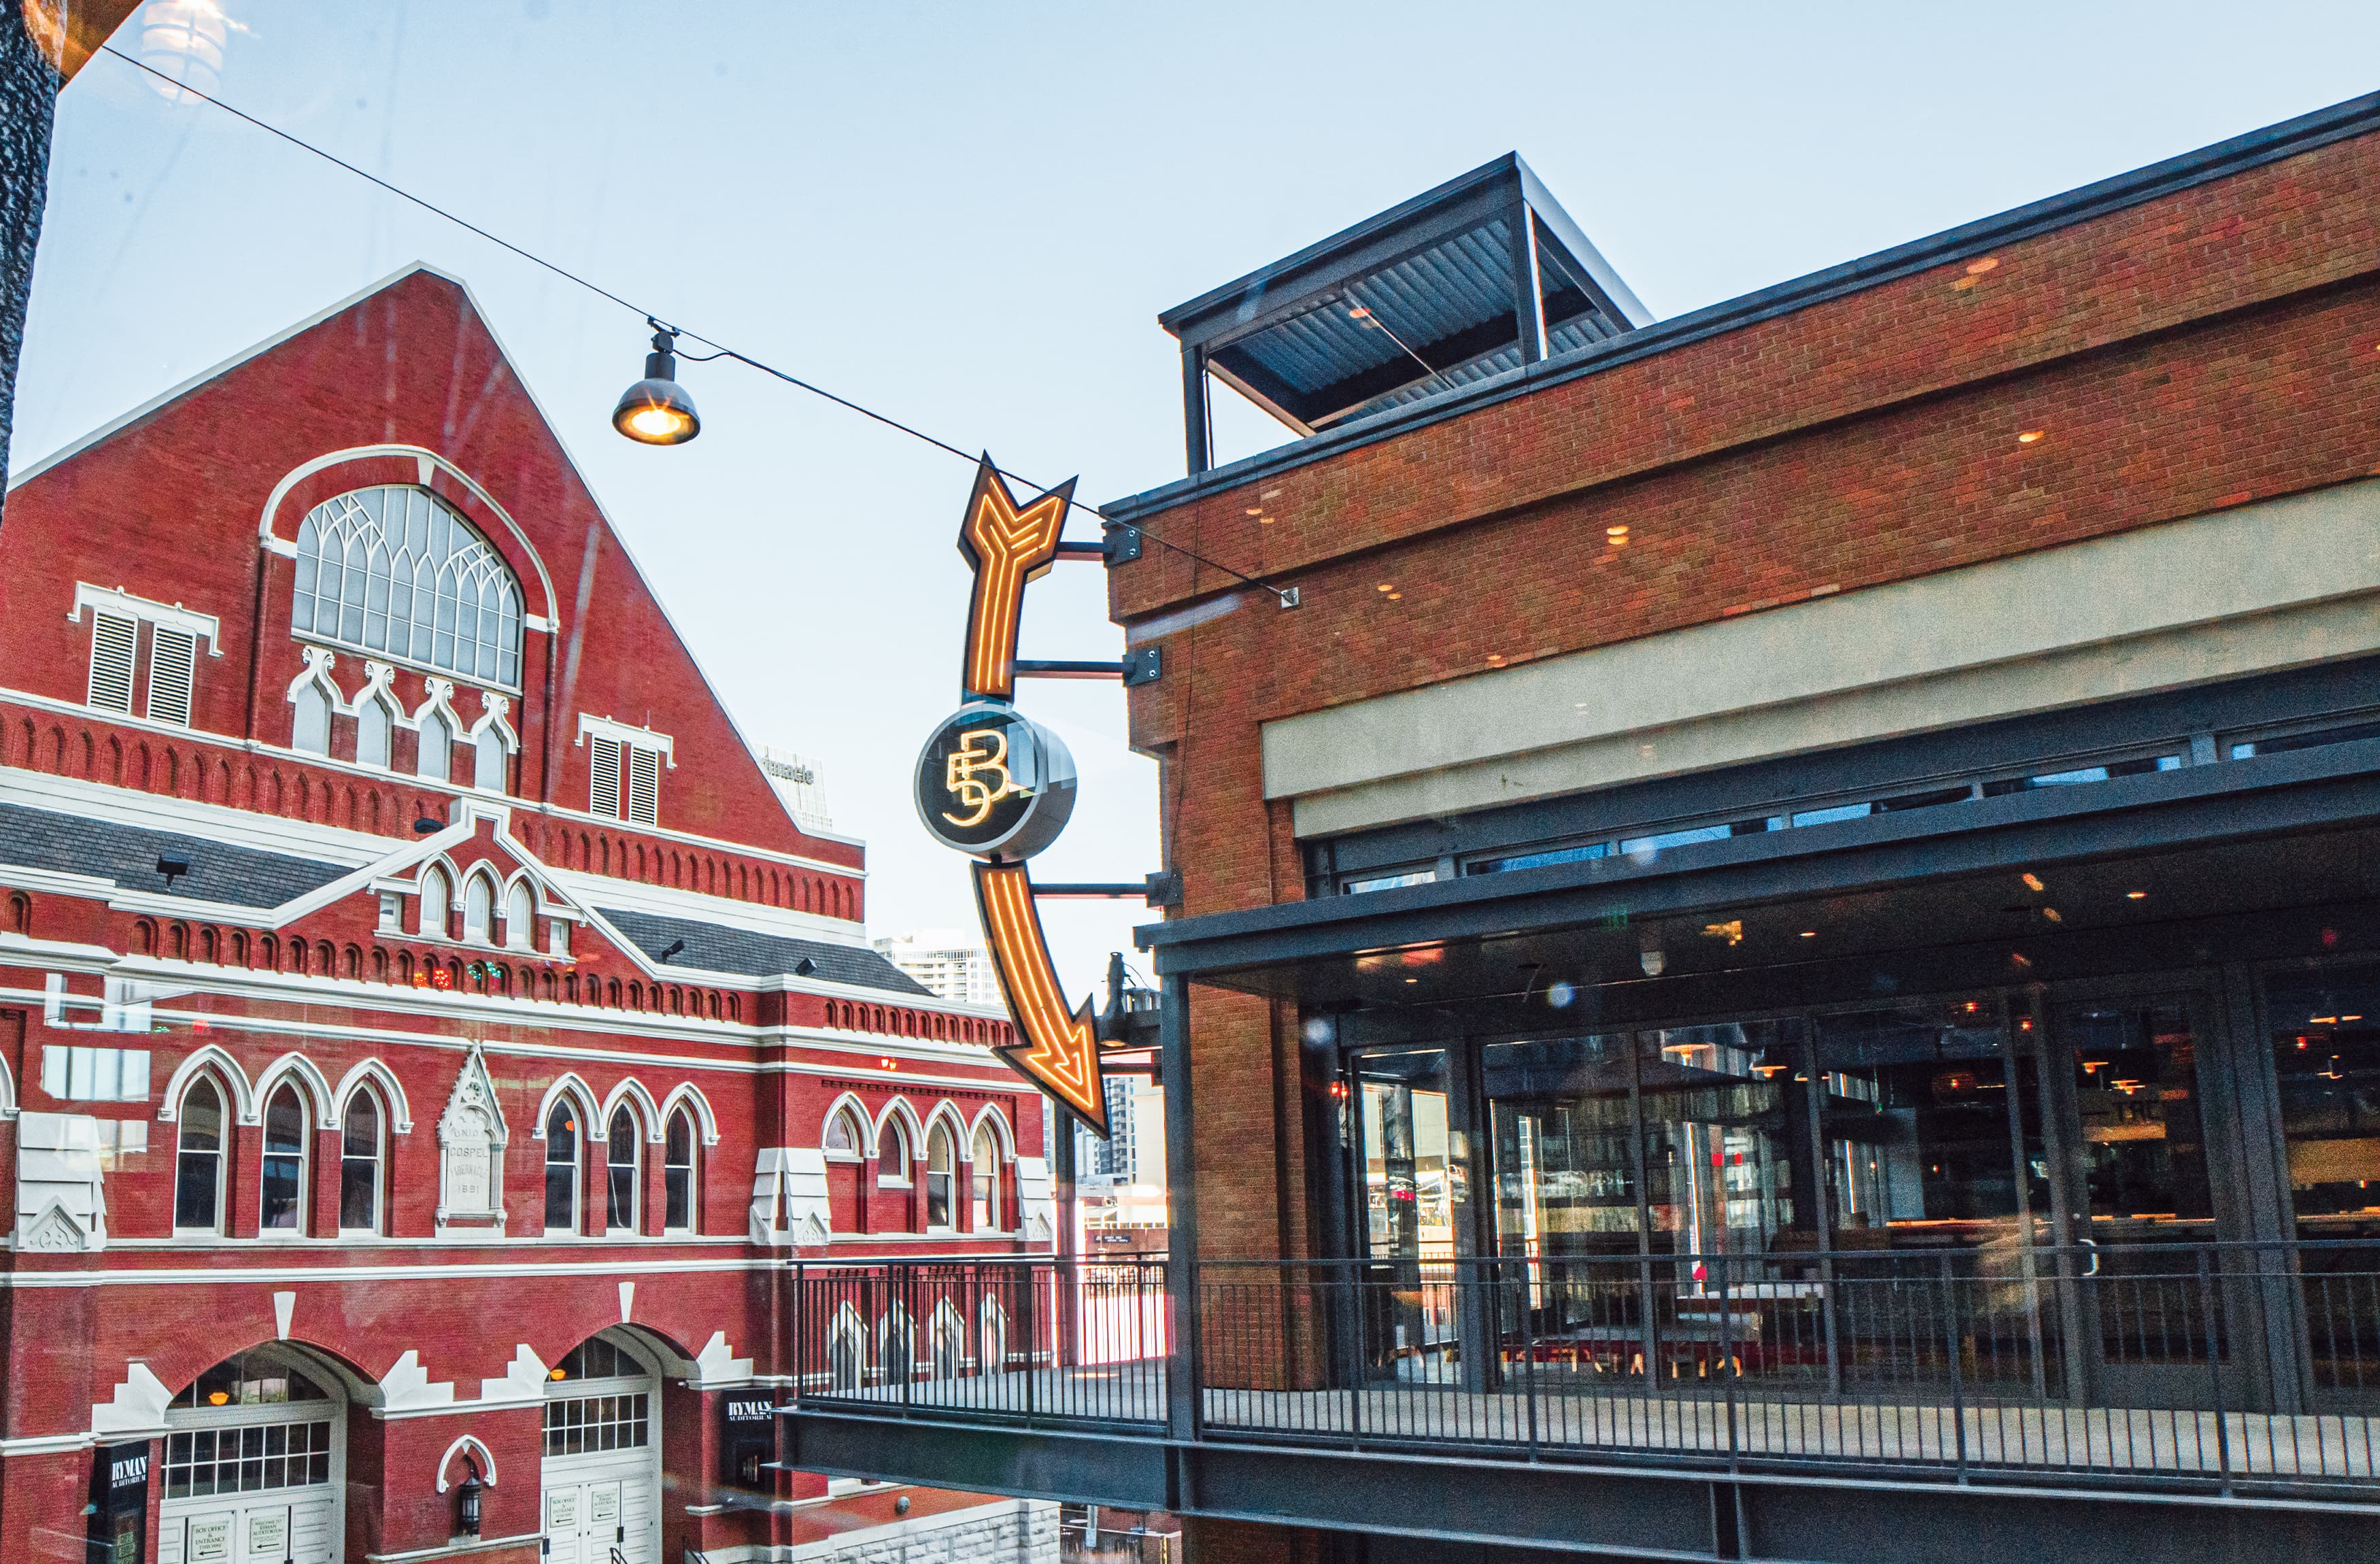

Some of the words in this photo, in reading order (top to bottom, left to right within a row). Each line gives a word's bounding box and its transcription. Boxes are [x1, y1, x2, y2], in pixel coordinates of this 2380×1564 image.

[761, 755, 814, 785] innacle
[450, 1147, 488, 1158] GOSPEL
[458, 1185, 479, 1195] 1891
[728, 1401, 772, 1416] RYMAN
[728, 1412, 772, 1422] AUDITORIUM
[111, 1456, 148, 1481] RYMAN
[112, 1474, 146, 1489] AUDITORIUM
[195, 1536, 225, 1545] ENTRANCE
